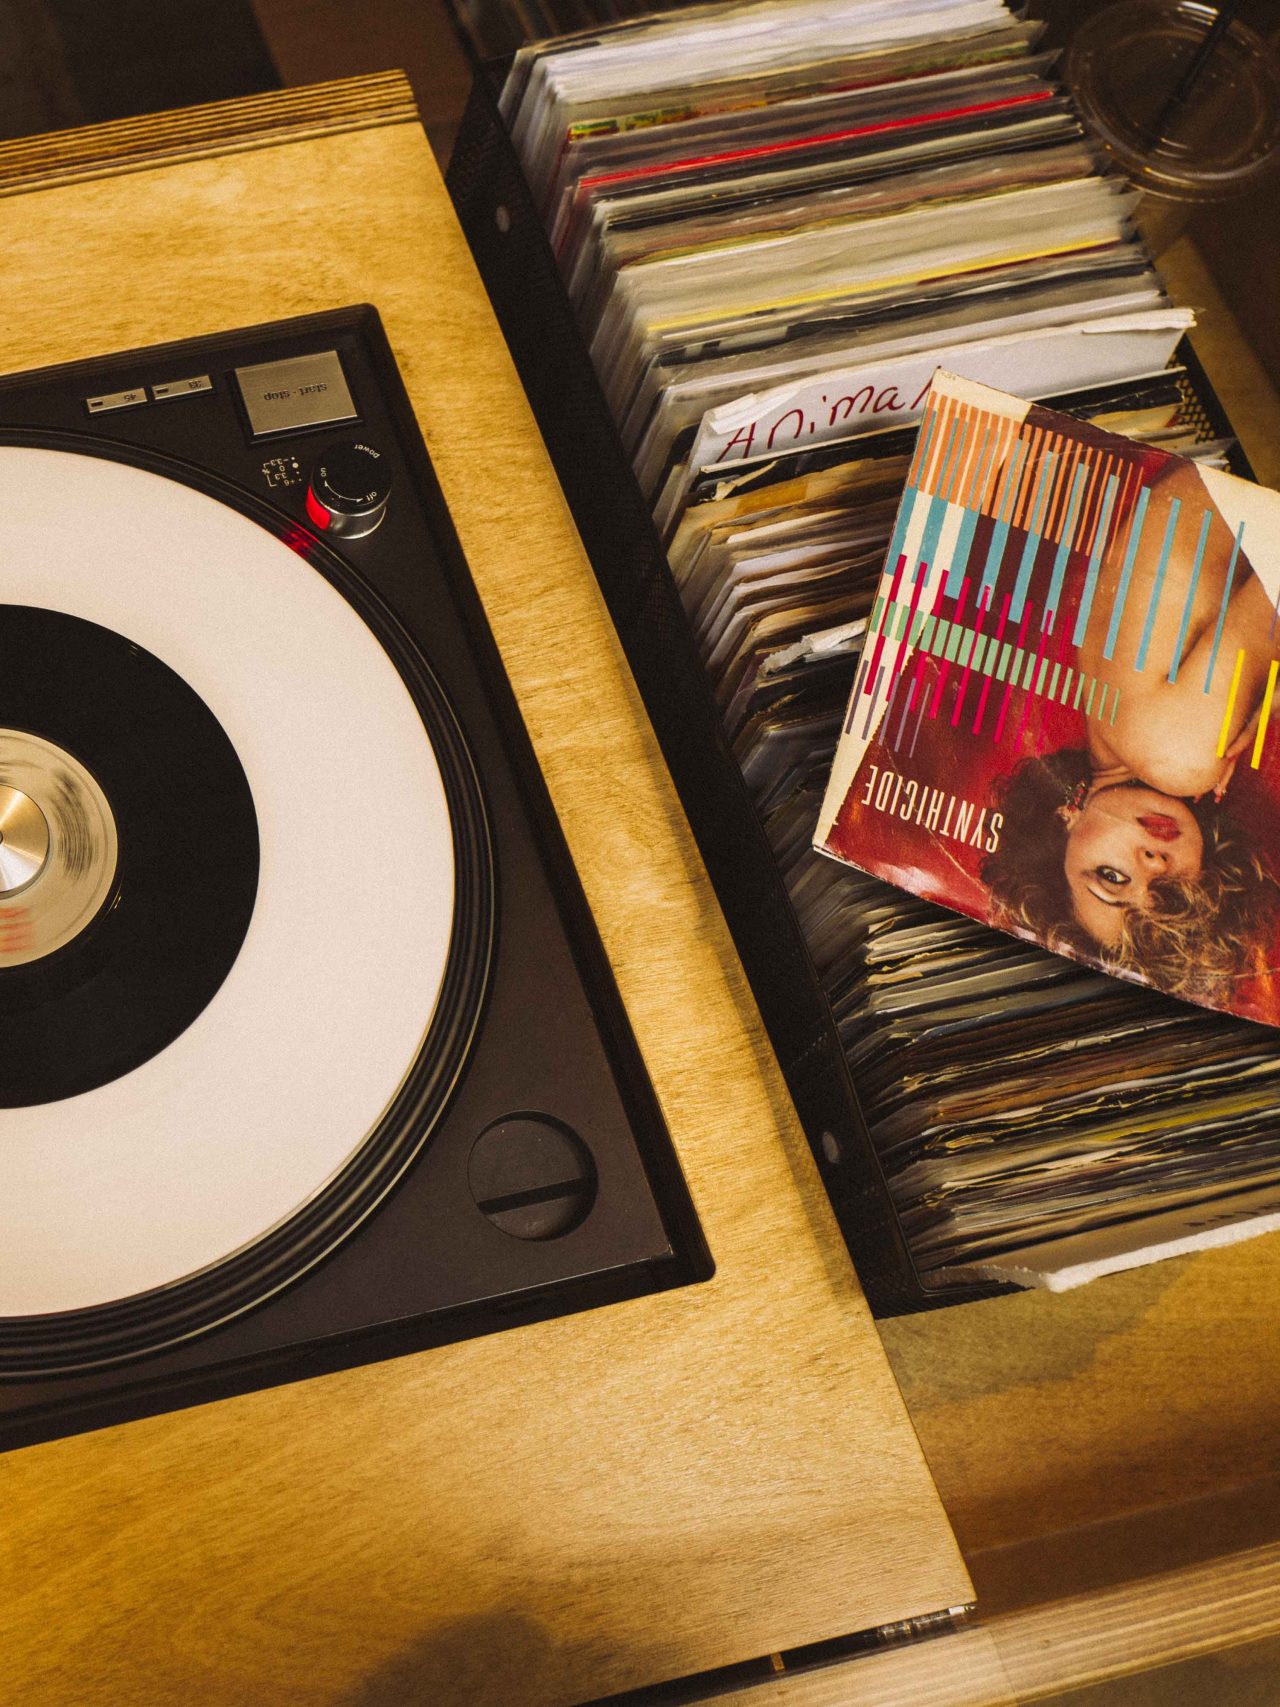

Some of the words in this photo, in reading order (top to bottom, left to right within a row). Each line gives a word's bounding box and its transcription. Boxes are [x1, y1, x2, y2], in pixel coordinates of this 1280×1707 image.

[298, 383, 327, 395] start
[264, 390, 290, 401] stop
[354, 444, 380, 459] power
[320, 467, 326, 477] on
[366, 491, 377, 501] off
[861, 764, 1004, 853] SYNTHICIDE
